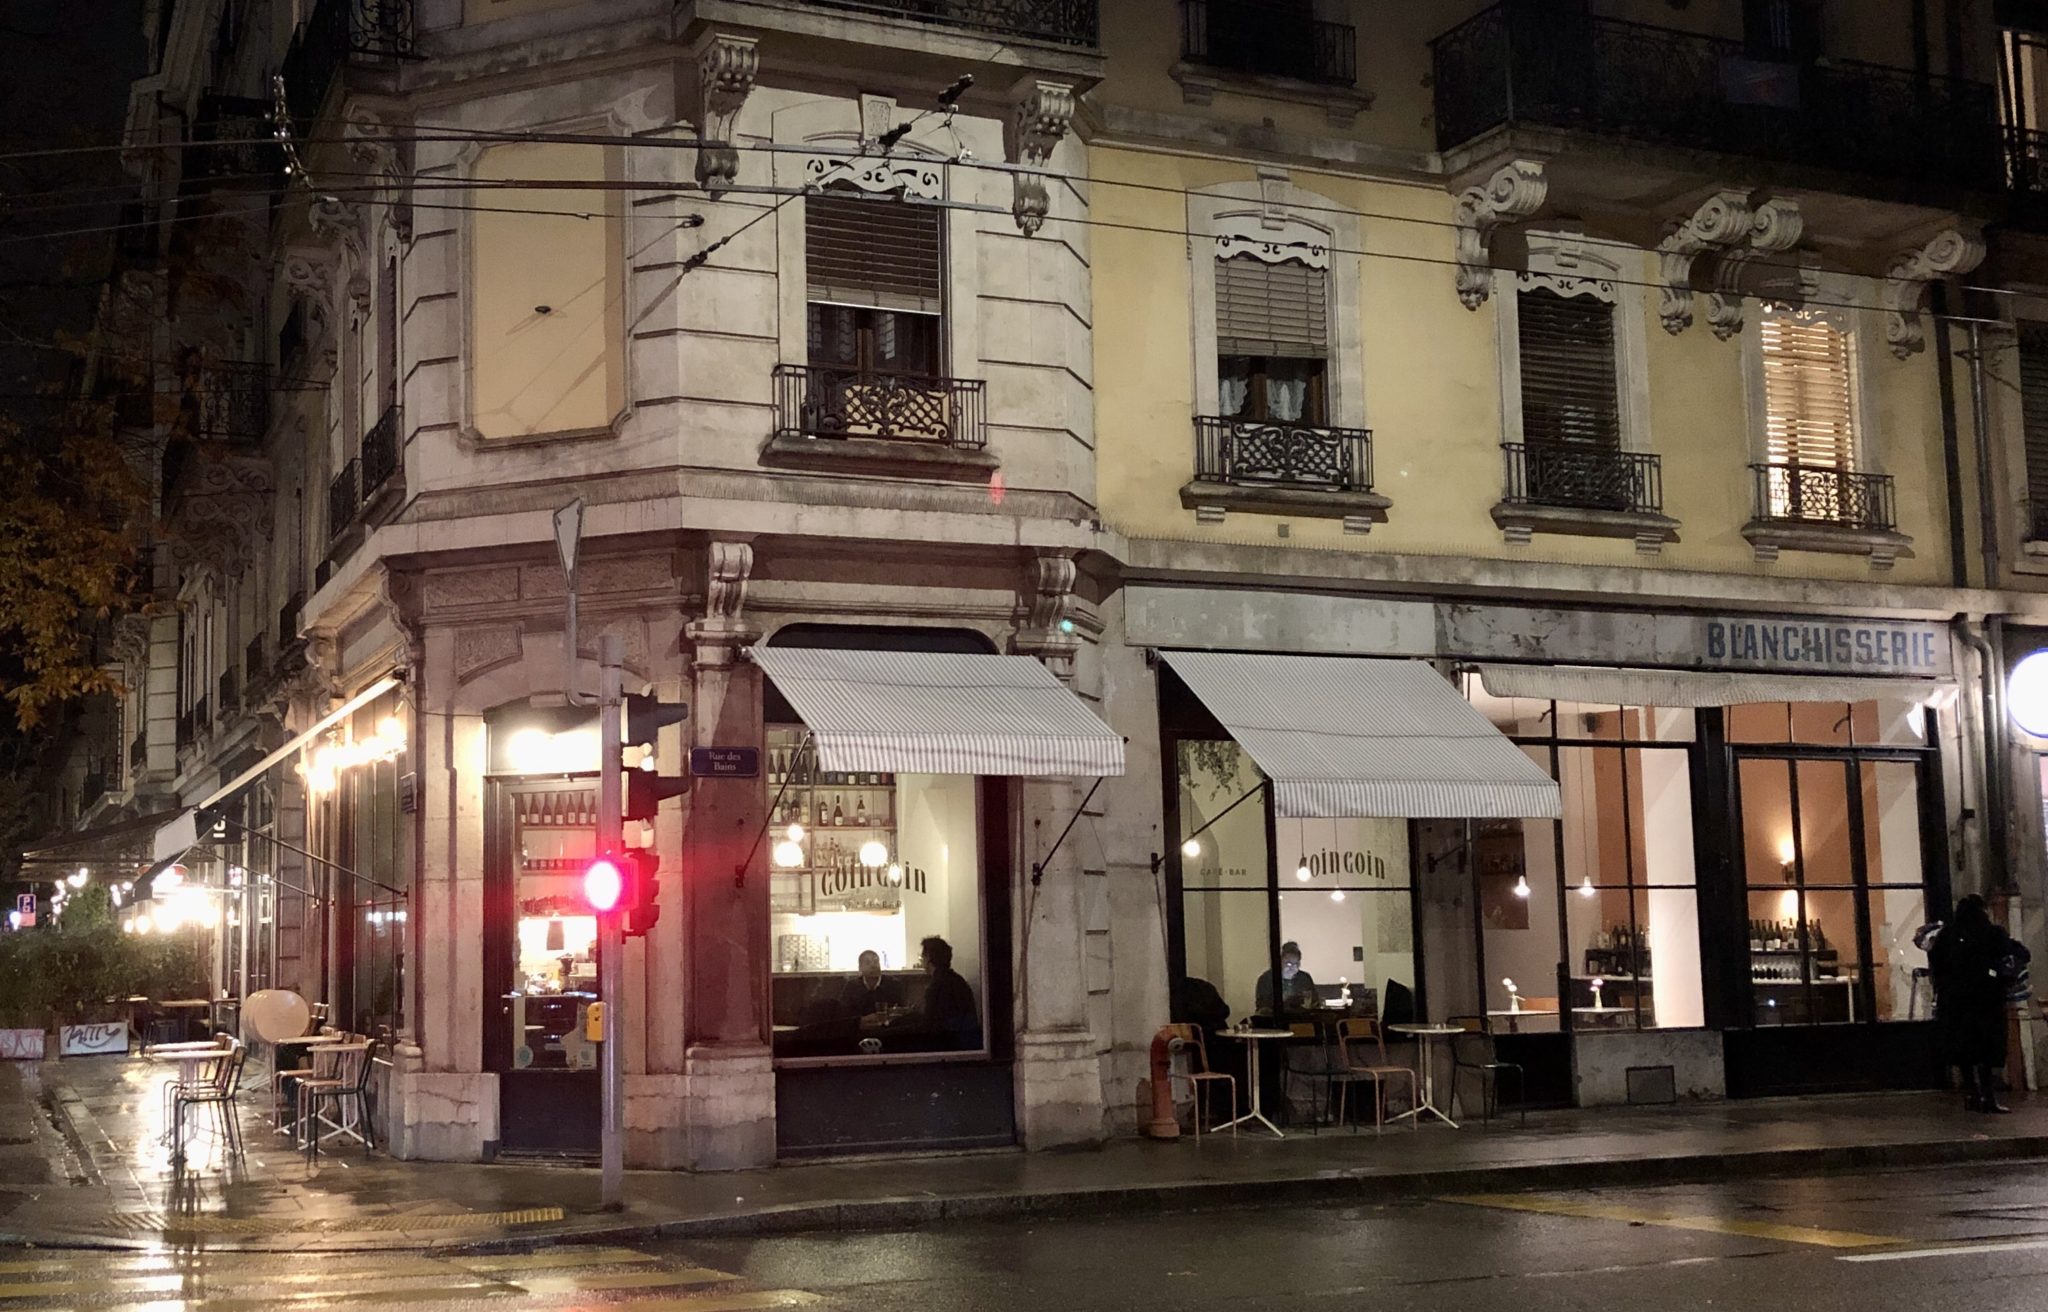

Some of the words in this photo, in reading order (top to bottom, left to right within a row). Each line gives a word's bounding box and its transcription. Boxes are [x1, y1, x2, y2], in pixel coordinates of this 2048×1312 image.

[1707, 622, 1937, 667] BLANCHISSERIE
[709, 751, 725, 761] Rue
[727, 751, 741, 761] des
[714, 761, 737, 771] Bains
